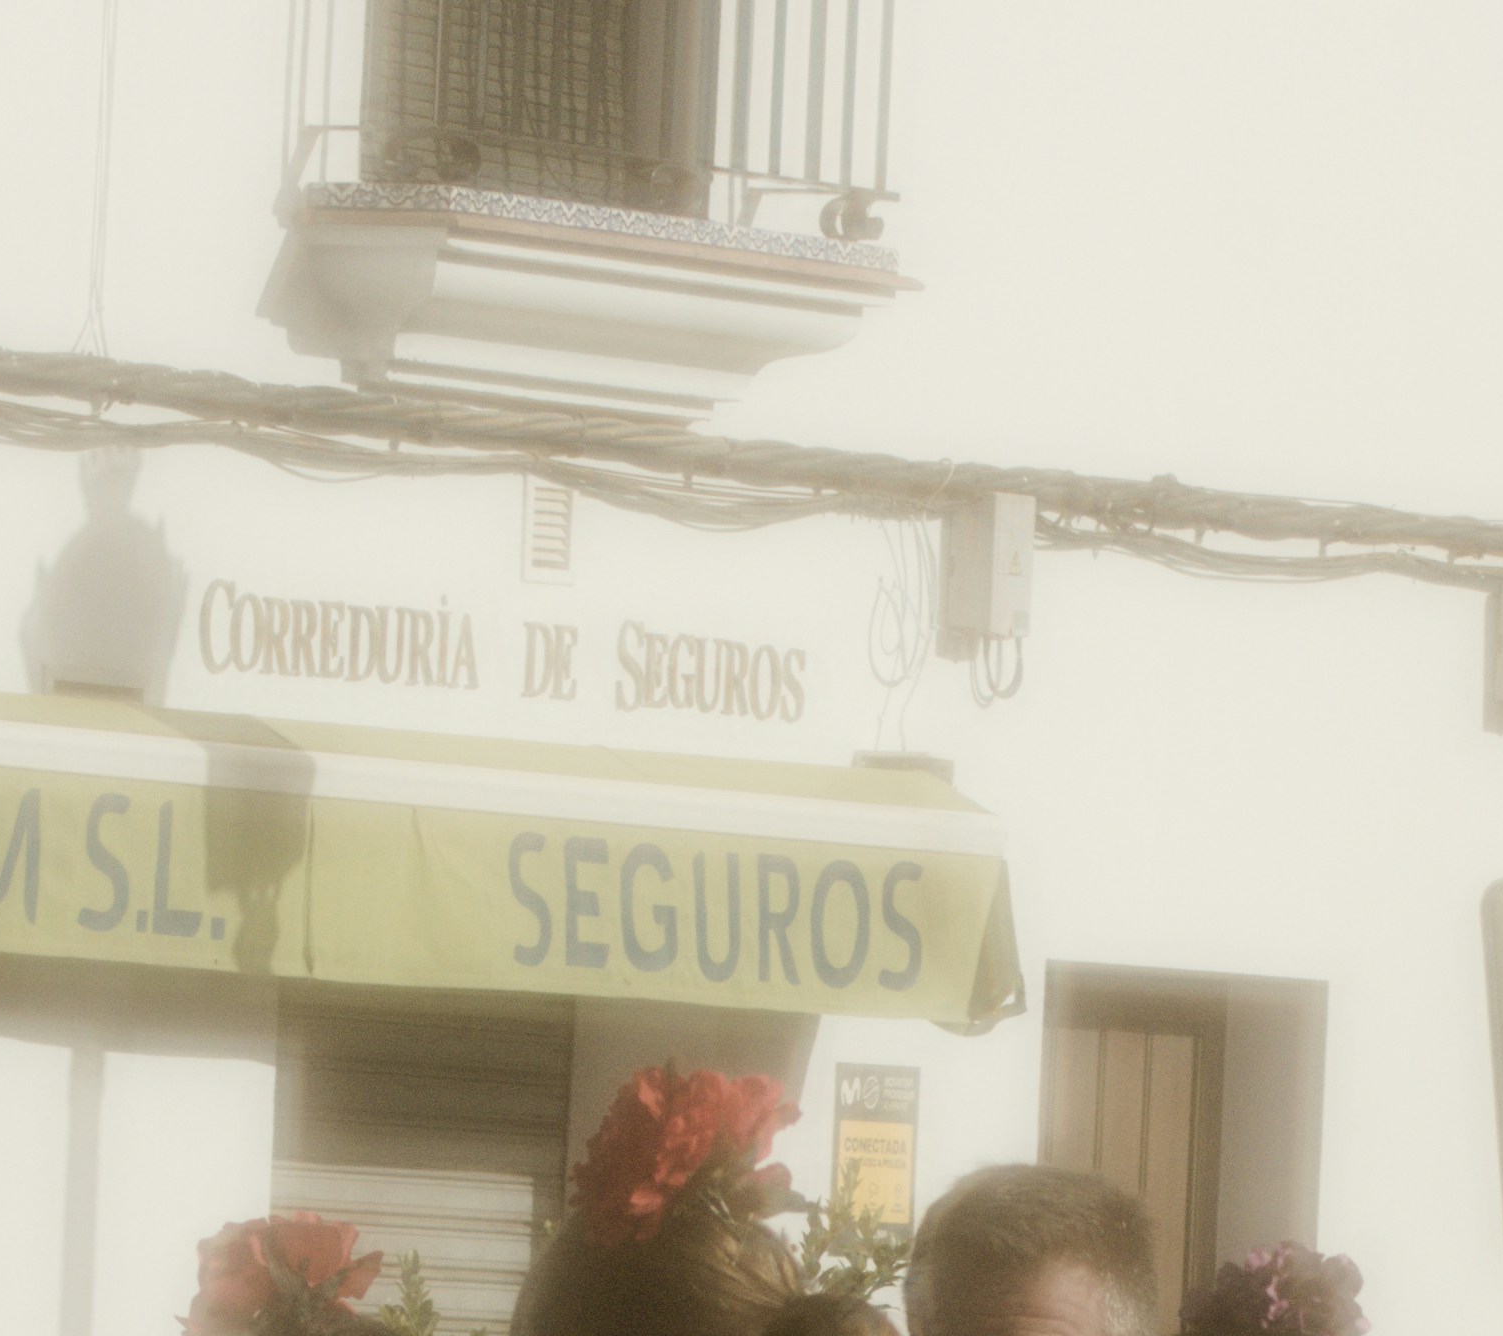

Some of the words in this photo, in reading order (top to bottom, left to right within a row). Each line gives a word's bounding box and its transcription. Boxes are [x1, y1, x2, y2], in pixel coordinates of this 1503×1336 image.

[521, 621, 578, 701] DE
[614, 619, 807, 724] SEGUROS
[77, 791, 227, 941] S.L.
[507, 830, 924, 991] SEGUROS
[843, 1136, 907, 1156] CONECTADA
